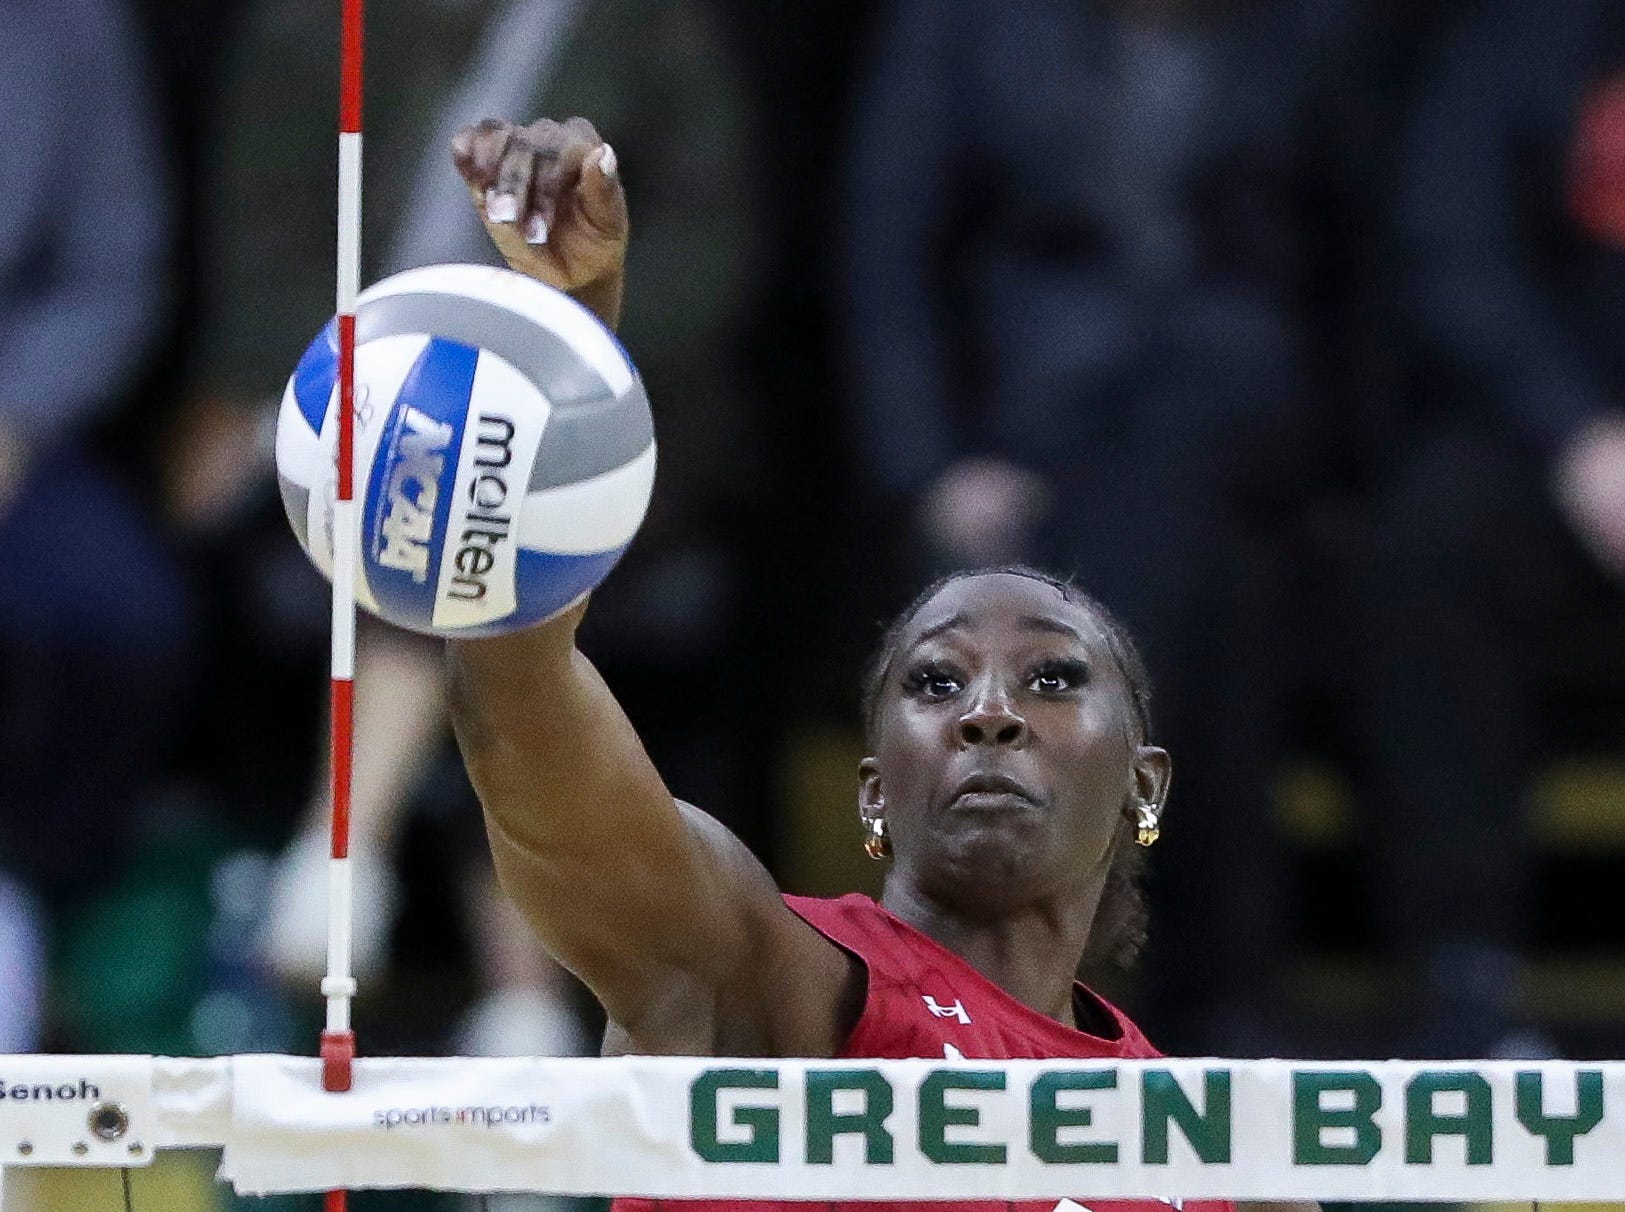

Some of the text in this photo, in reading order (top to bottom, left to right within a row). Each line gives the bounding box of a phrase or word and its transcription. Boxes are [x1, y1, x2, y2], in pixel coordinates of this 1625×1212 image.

[378, 403, 455, 585] NCAA
[446, 413, 516, 601] molten
[688, 1068, 1605, 1166] GREEN BAY
